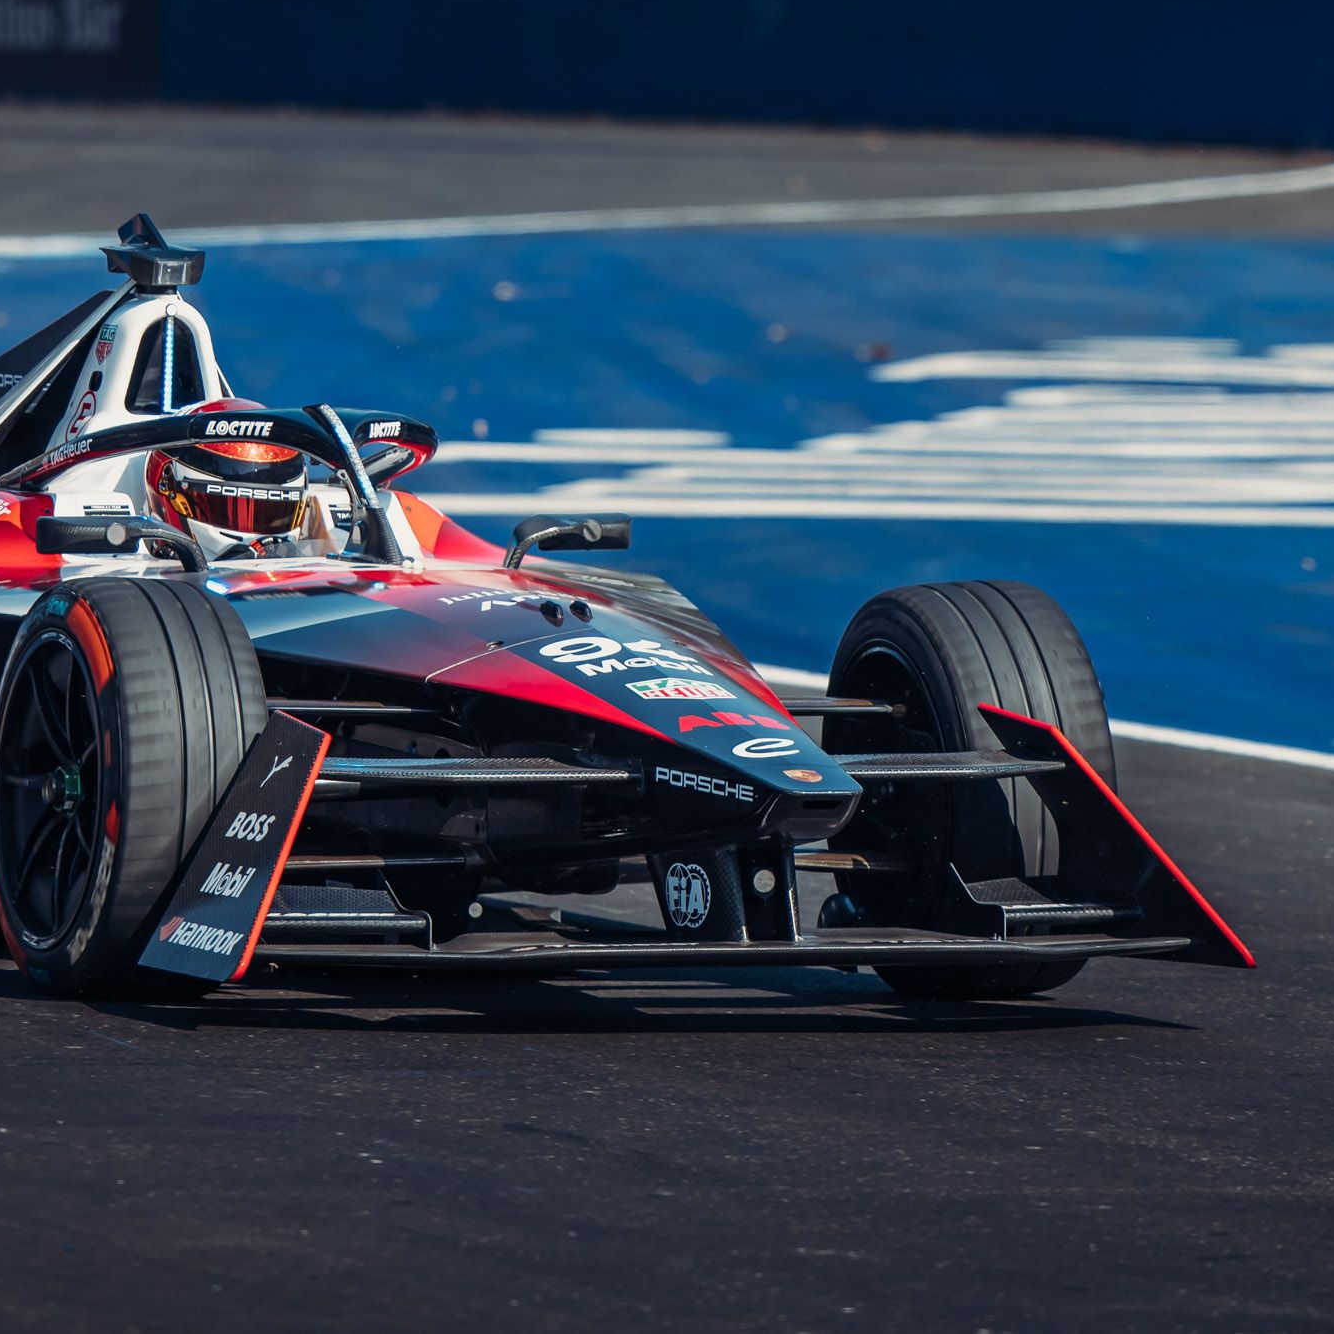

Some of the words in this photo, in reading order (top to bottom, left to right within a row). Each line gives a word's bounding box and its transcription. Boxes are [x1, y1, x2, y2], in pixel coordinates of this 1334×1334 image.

[205, 420, 274, 437] LOCTITE
[369, 421, 401, 438] LOCTITE
[207, 484, 300, 501] PORSCHE
[575, 657, 714, 677] Mobil
[634, 678, 724, 691] TAG
[641, 686, 733, 699] HEUER
[678, 711, 791, 733] ABB
[656, 767, 754, 802] PORSCHE
[225, 811, 276, 842] BOSS
[200, 862, 256, 898] Mobil
